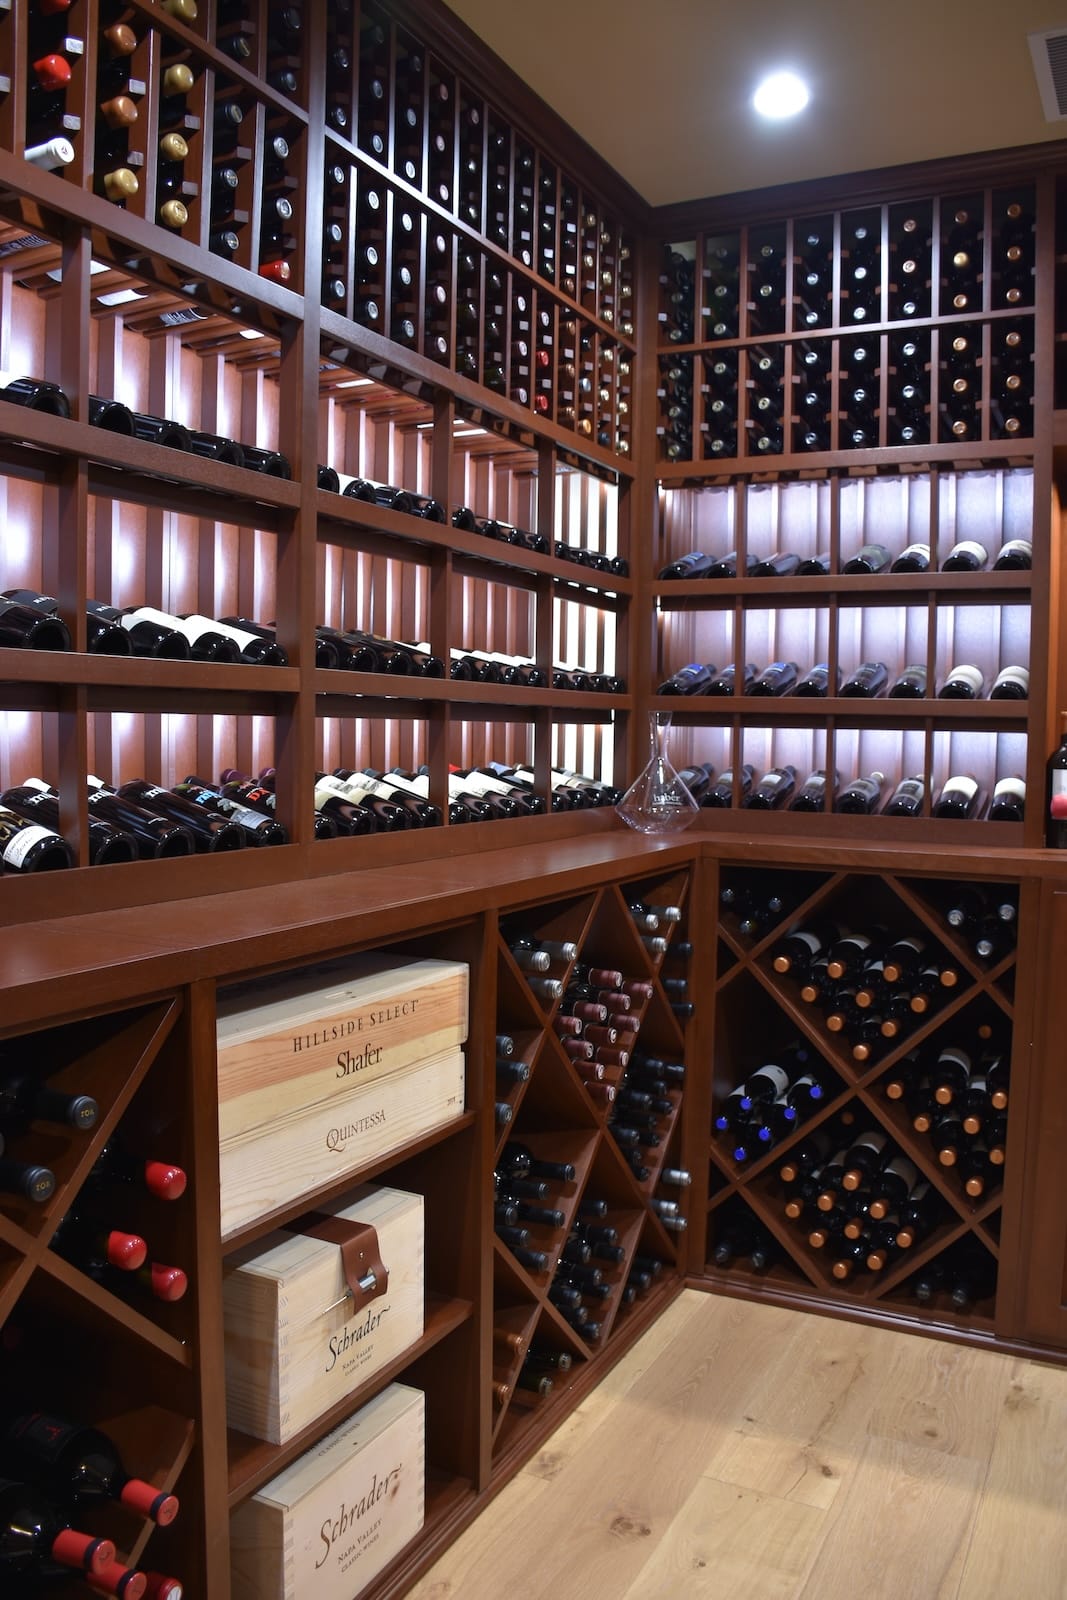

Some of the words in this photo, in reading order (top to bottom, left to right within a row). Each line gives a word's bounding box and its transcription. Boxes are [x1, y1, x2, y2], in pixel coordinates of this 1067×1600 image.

[293, 1017, 363, 1052] HILLSIDE
[369, 1000, 418, 1027] SELECT
[326, 1110, 386, 1152] QUINTESSA
[326, 1305, 391, 1372] Schrader
[315, 1463, 402, 1569] Schrader
[338, 1544, 356, 1564] NAPA
[357, 1518, 382, 1544] VALLEY
